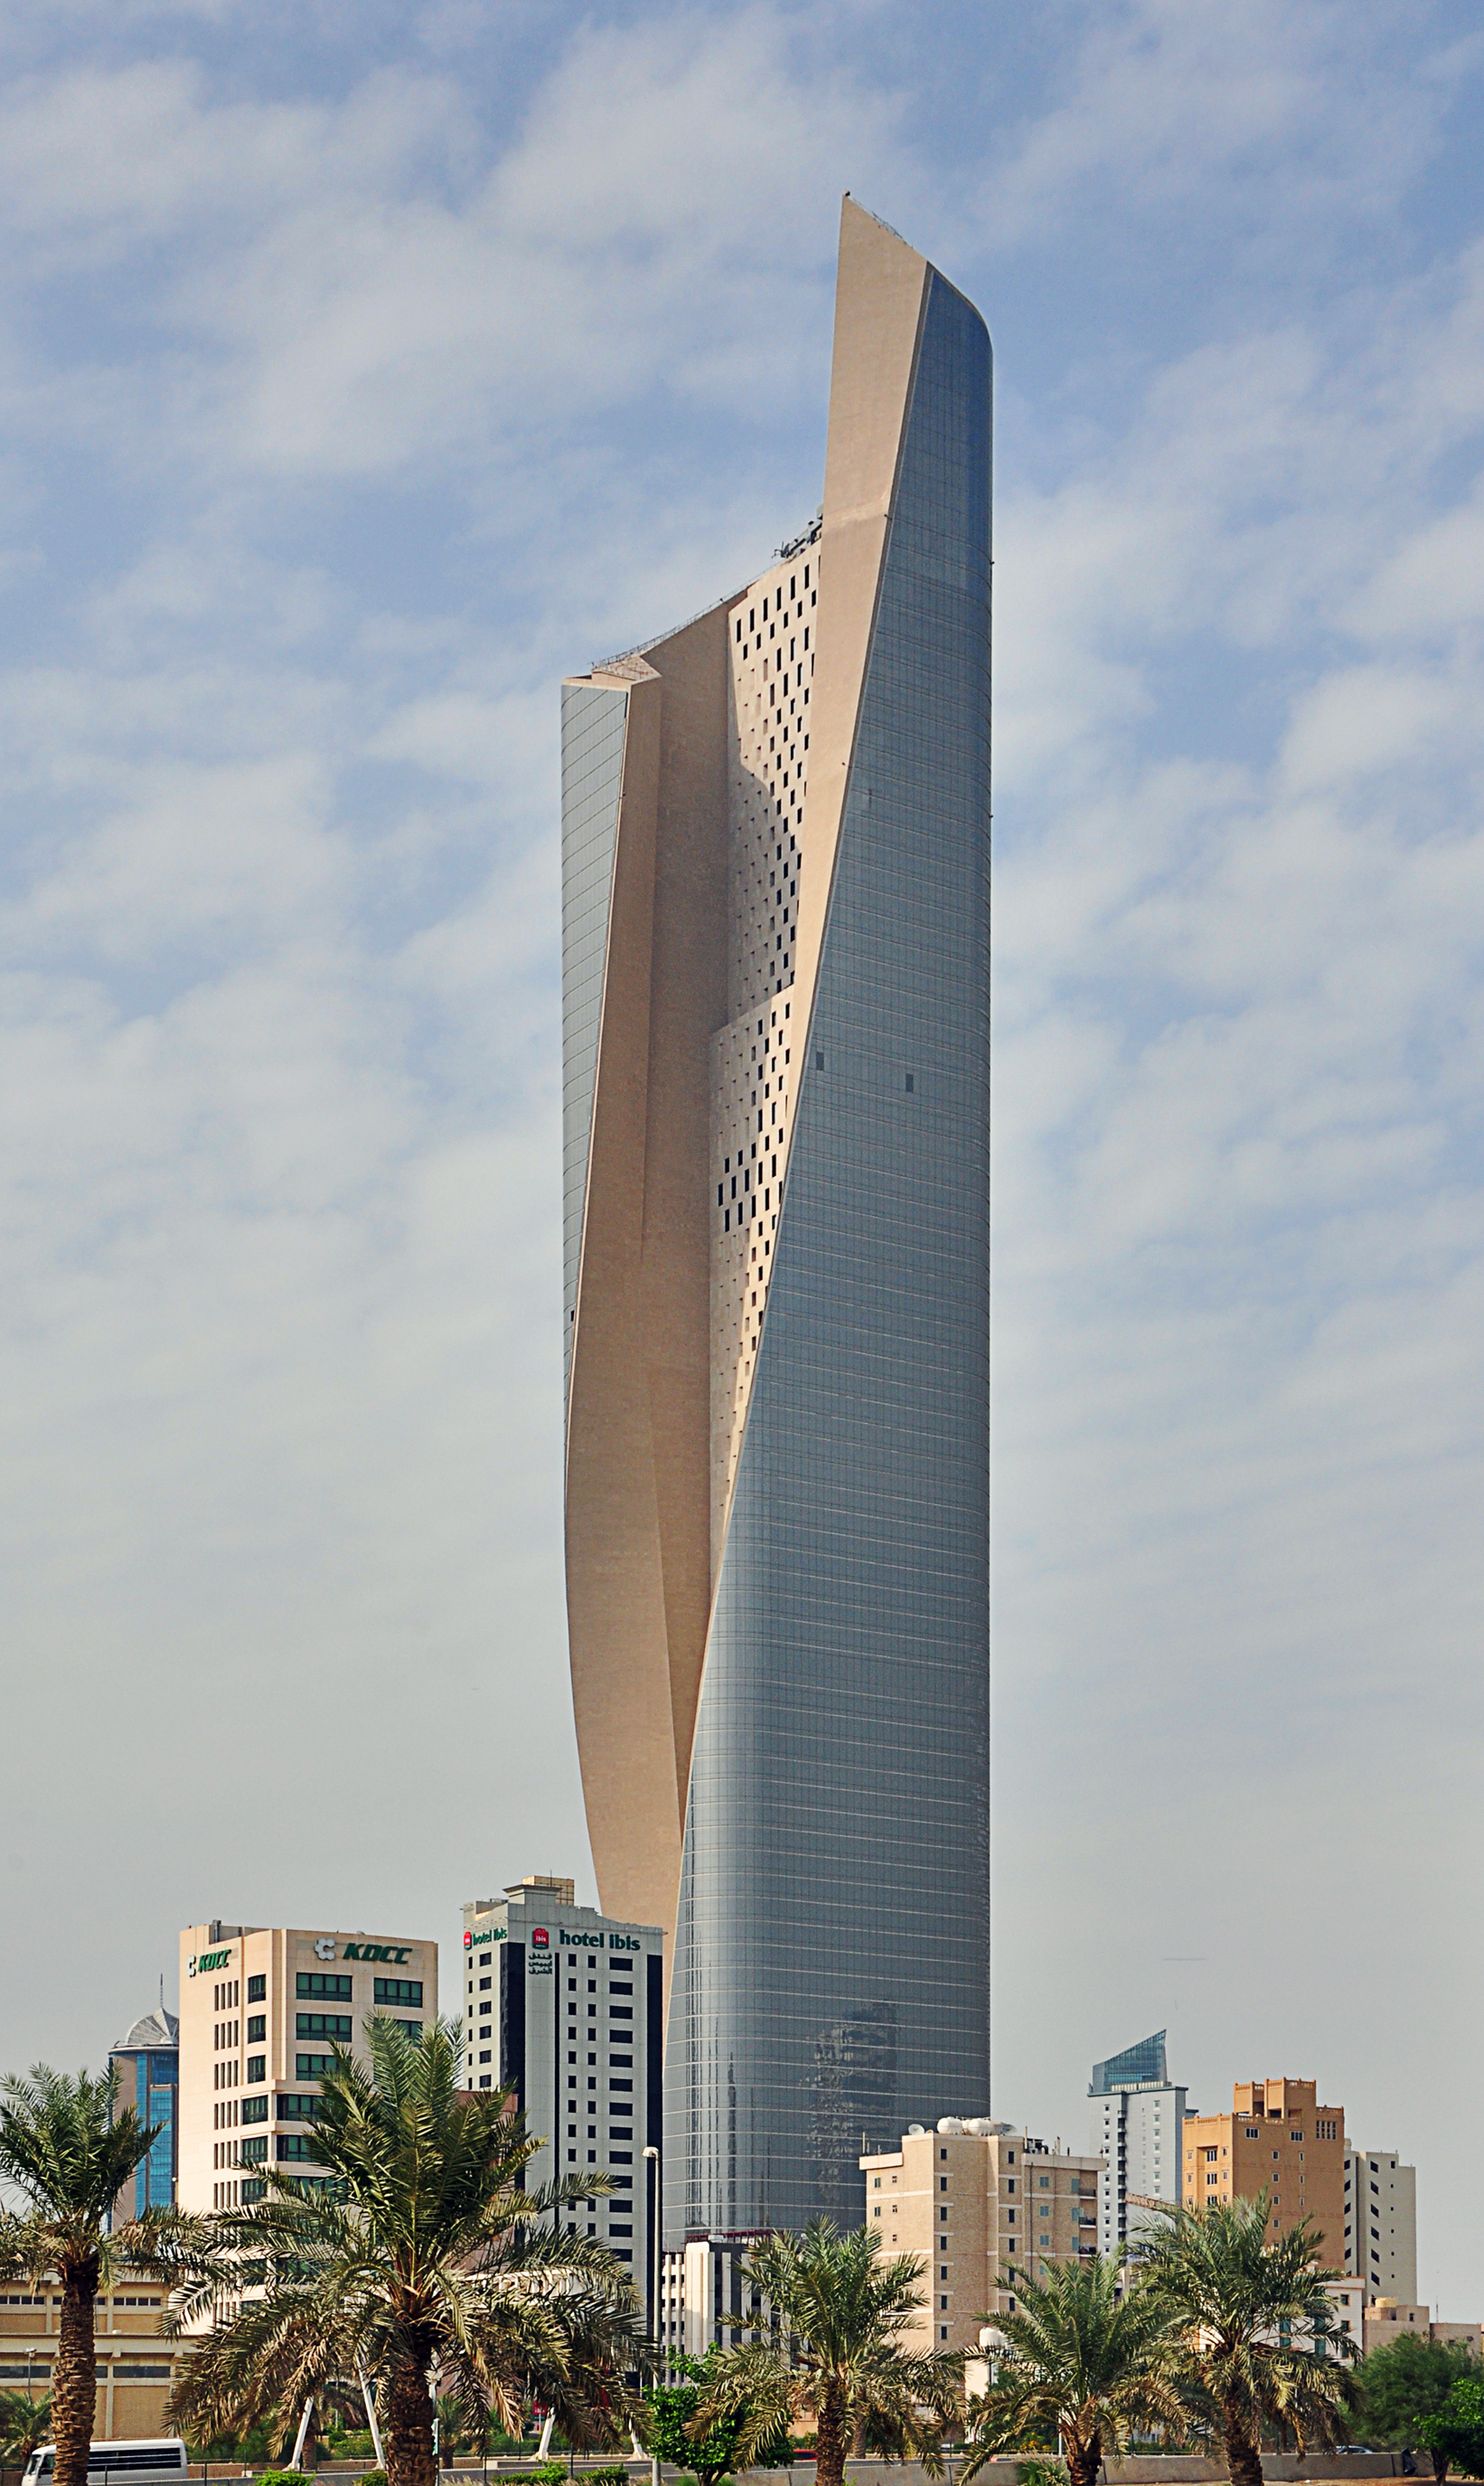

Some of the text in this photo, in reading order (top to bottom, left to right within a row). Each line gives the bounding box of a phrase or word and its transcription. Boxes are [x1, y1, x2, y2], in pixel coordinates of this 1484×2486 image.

[473, 1929, 493, 1945] hotel
[559, 1929, 641, 1951] hotel ibis
[197, 1949, 232, 1973] KDCC
[343, 1943, 413, 1964] KDCC
[528, 1952, 553, 1960] فندق
